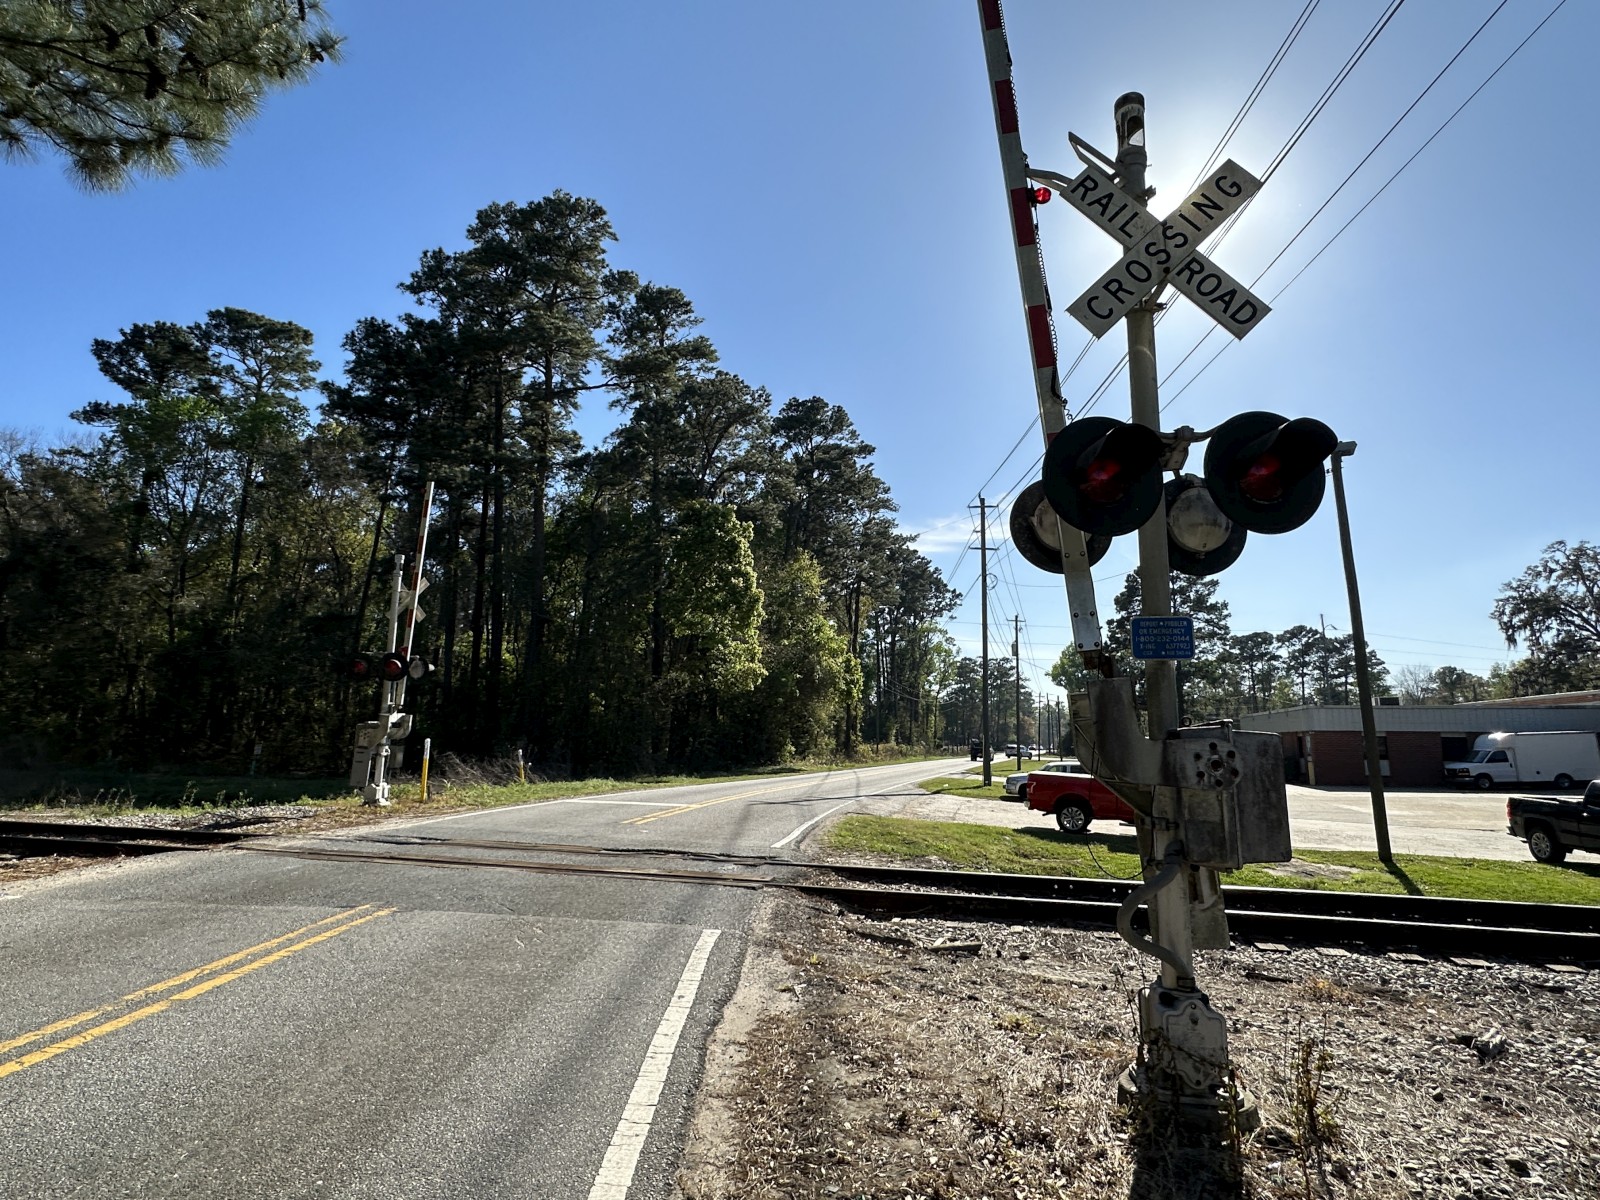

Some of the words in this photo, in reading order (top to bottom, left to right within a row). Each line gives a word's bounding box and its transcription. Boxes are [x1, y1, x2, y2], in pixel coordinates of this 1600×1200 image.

[1071, 175, 1139, 239] RAIL
[1175, 256, 1258, 325] ROAD
[1086, 175, 1242, 320] CROSSING
